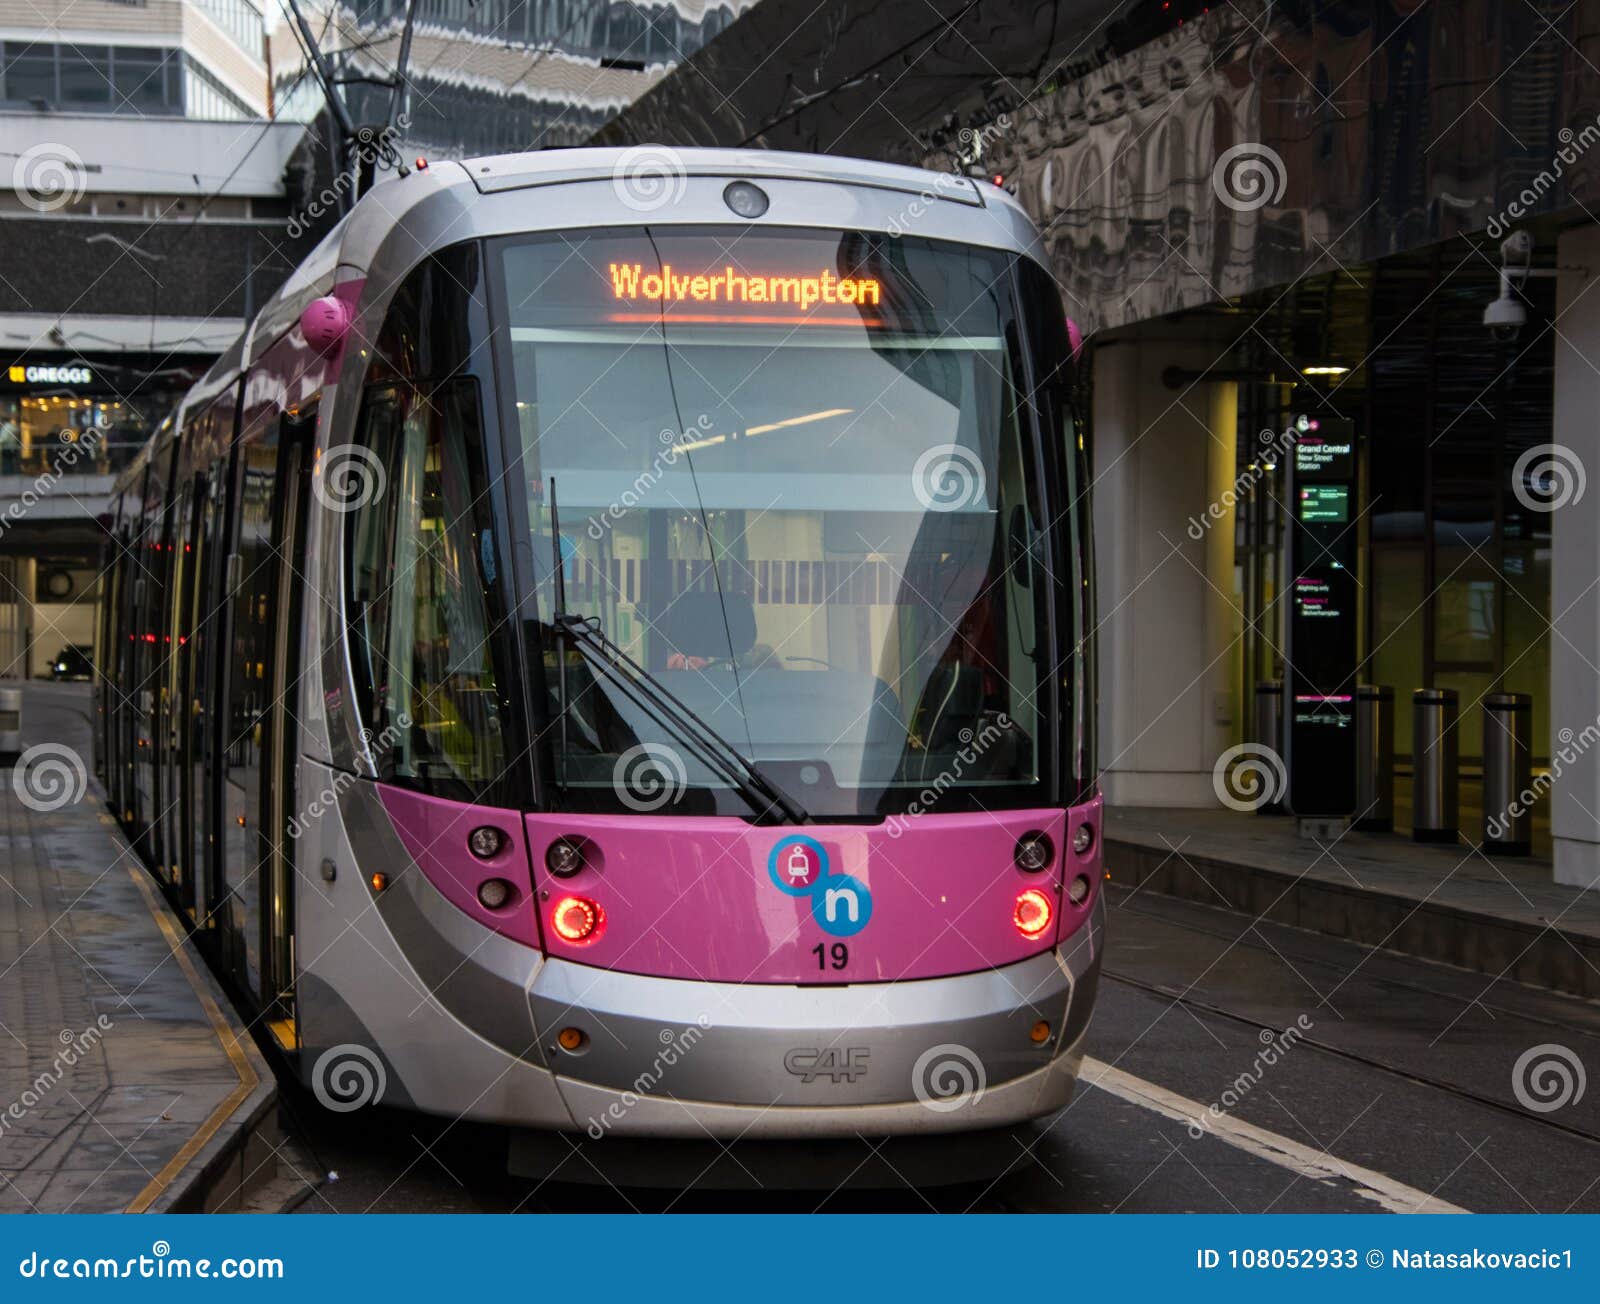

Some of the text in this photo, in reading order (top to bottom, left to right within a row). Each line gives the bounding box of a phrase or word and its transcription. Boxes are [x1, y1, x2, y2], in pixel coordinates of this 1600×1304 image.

[610, 263, 880, 310] Wolverhampton
[26, 366, 92, 383] GREGGS
[1298, 443, 1351, 453] Grand Central
[1298, 454, 1333, 462] New Street
[1298, 462, 1321, 470] Station
[825, 887, 860, 923] n
[812, 942, 849, 971] 19
[784, 1047, 871, 1084] CAF
